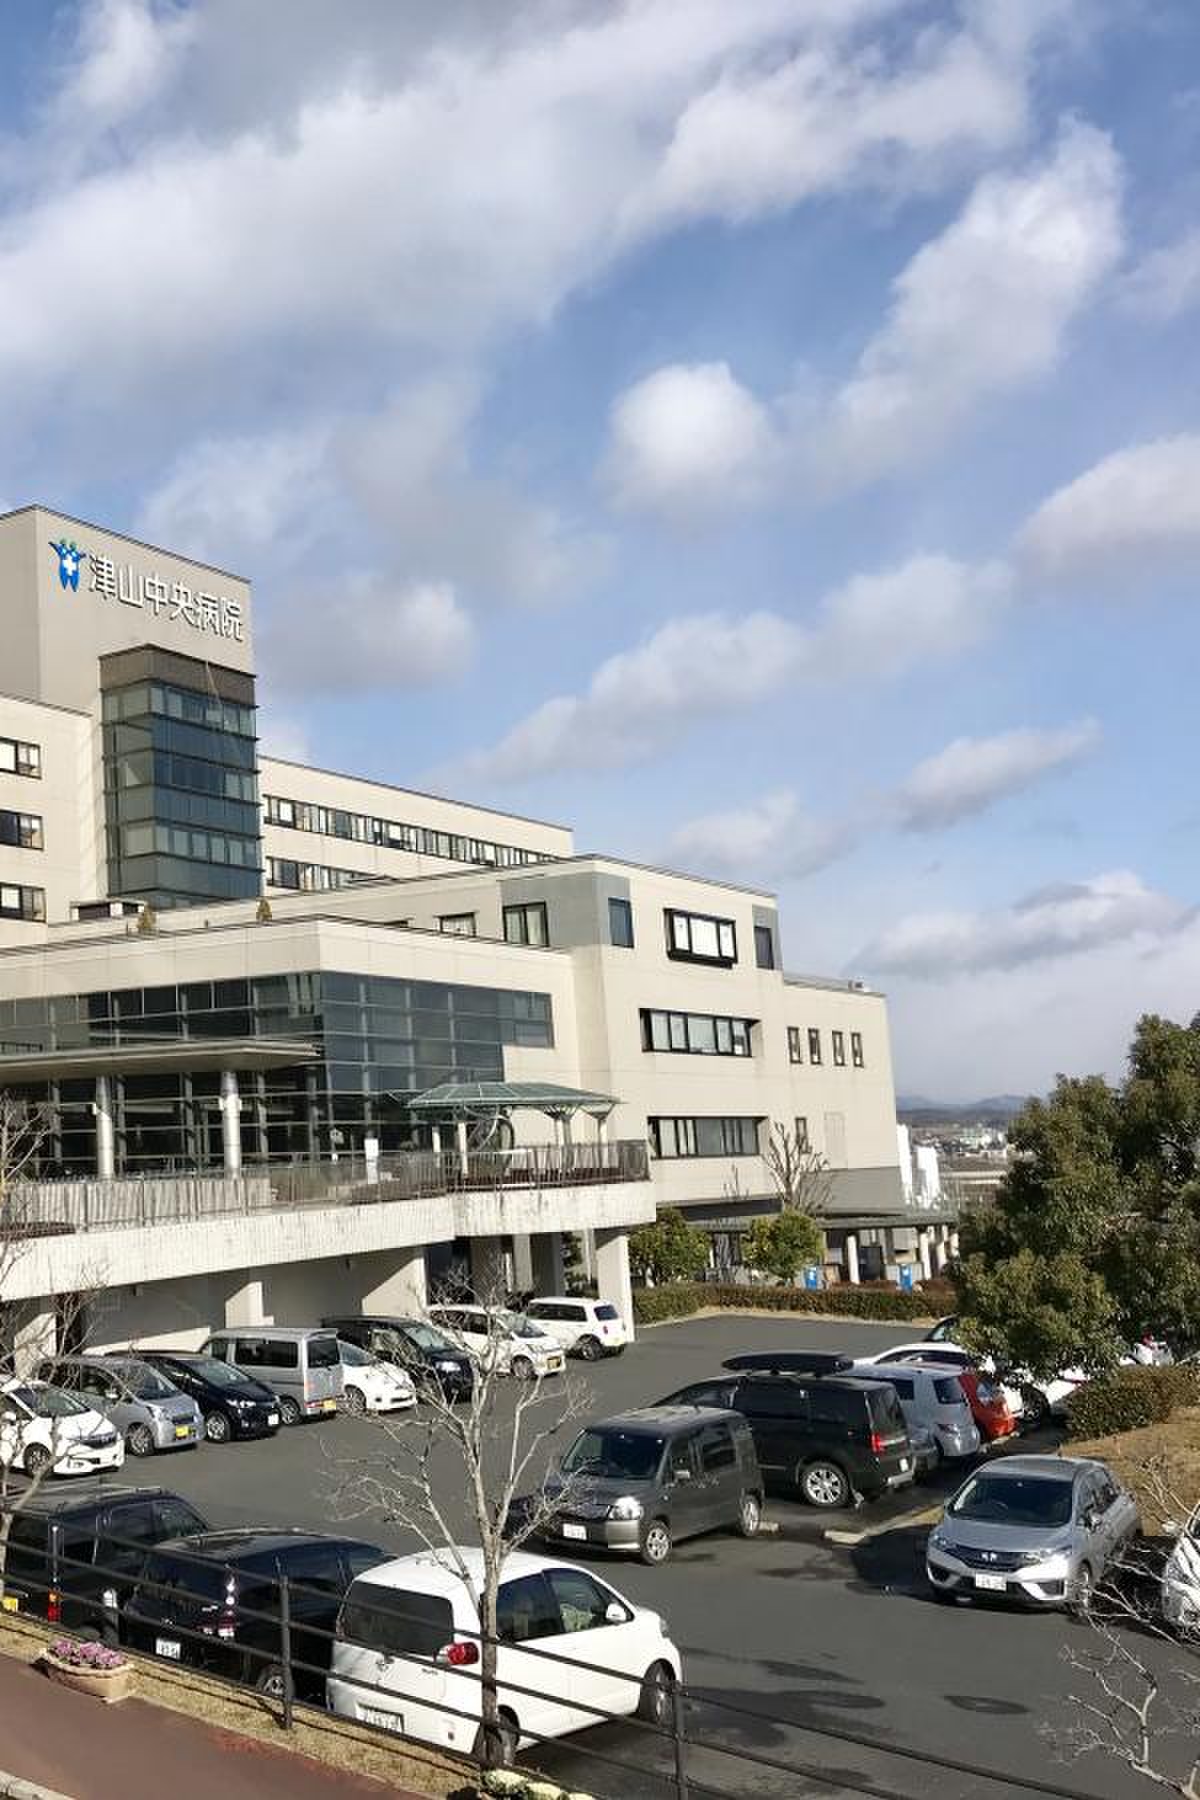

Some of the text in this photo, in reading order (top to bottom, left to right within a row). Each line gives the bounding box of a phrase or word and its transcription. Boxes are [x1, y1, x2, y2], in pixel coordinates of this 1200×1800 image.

[89, 554, 243, 640] 津山中央病院
